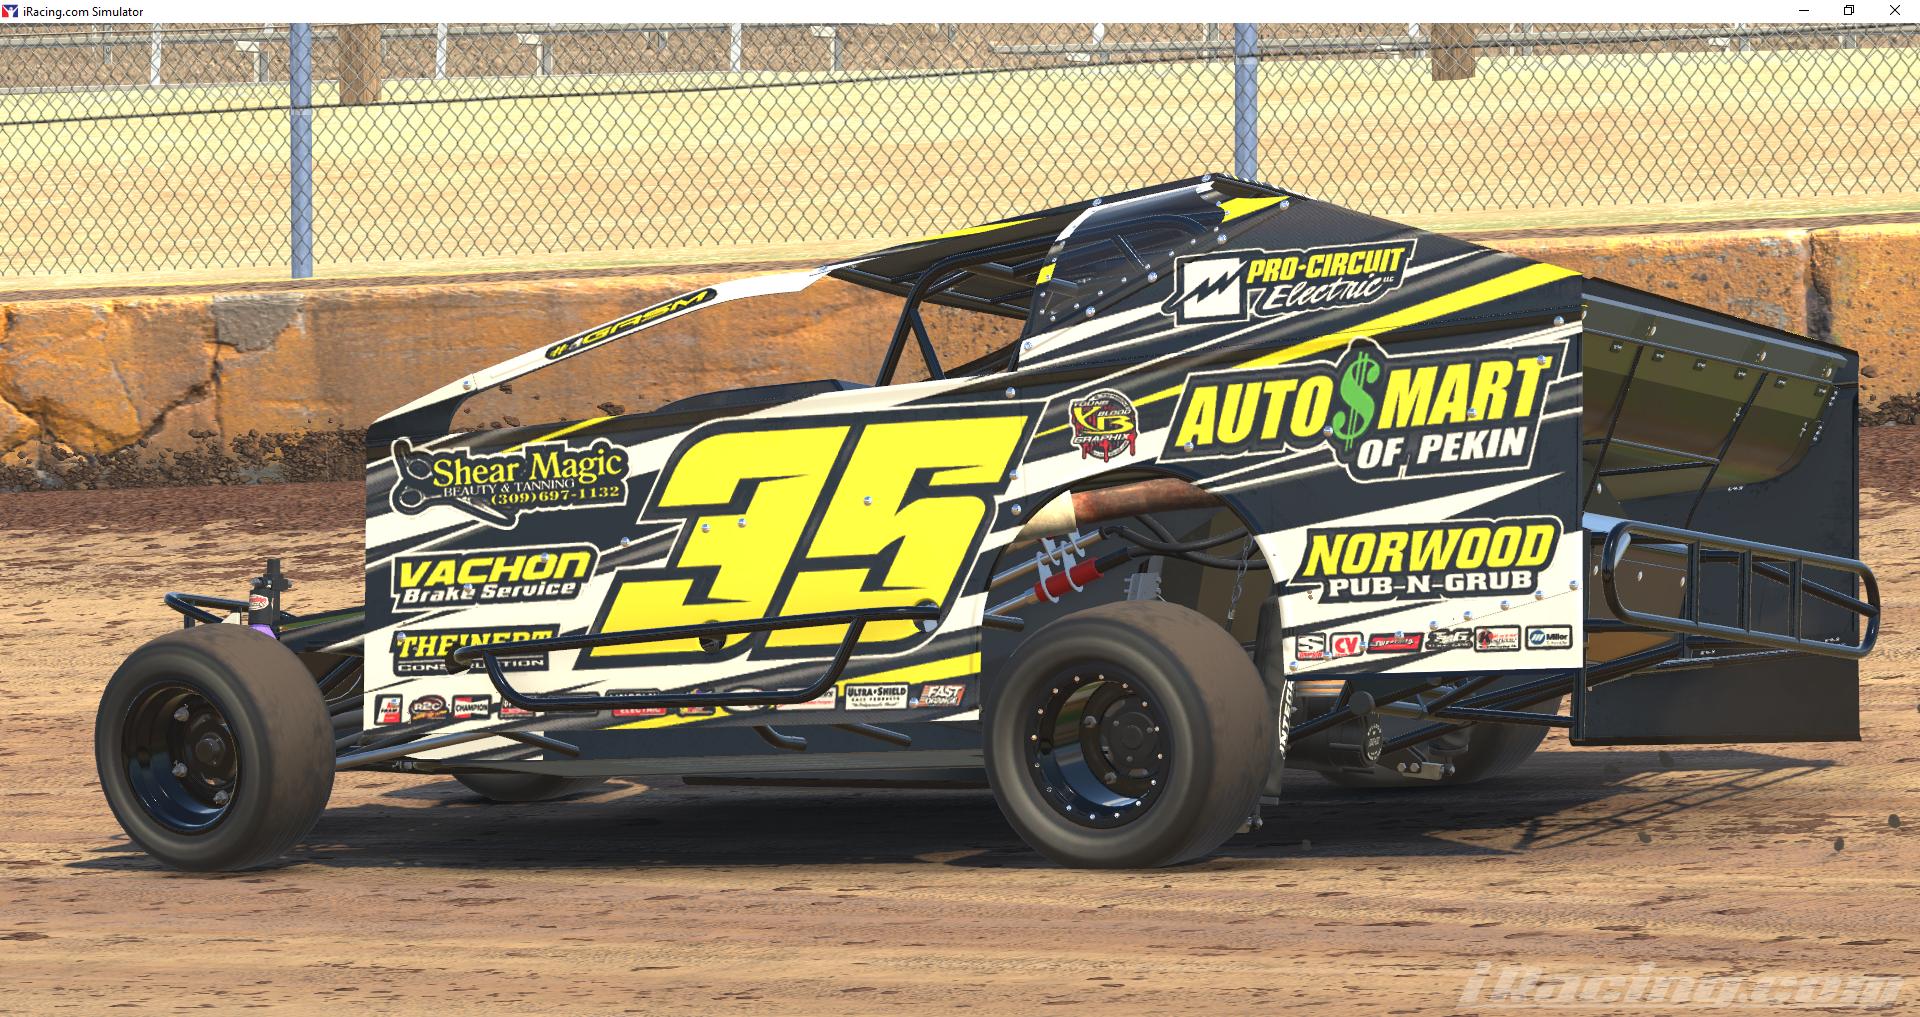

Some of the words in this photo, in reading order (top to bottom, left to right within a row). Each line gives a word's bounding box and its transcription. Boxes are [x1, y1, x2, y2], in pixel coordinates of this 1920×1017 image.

[23, 7, 89, 19] iRacing.com
[92, 7, 144, 17] Simulator
[1262, 272, 1384, 310] Electric
[1357, 437, 1402, 470] OF
[1417, 427, 1528, 465] PEKIN
[432, 458, 520, 487] Shear
[529, 449, 622, 485] Magic
[443, 485, 497, 498] BEAUTY
[501, 484, 510, 493] &
[513, 478, 575, 493] TANNING
[590, 416, 1028, 658] 35
[1302, 524, 1555, 577] NORWOOD
[400, 552, 592, 588] VACHON
[1328, 570, 1532, 598] PUB-N-GRUB
[402, 587, 476, 604] Brake
[480, 581, 577, 599] Service
[928, 685, 963, 697] FAST
[455, 703, 489, 713] CHAMPION
